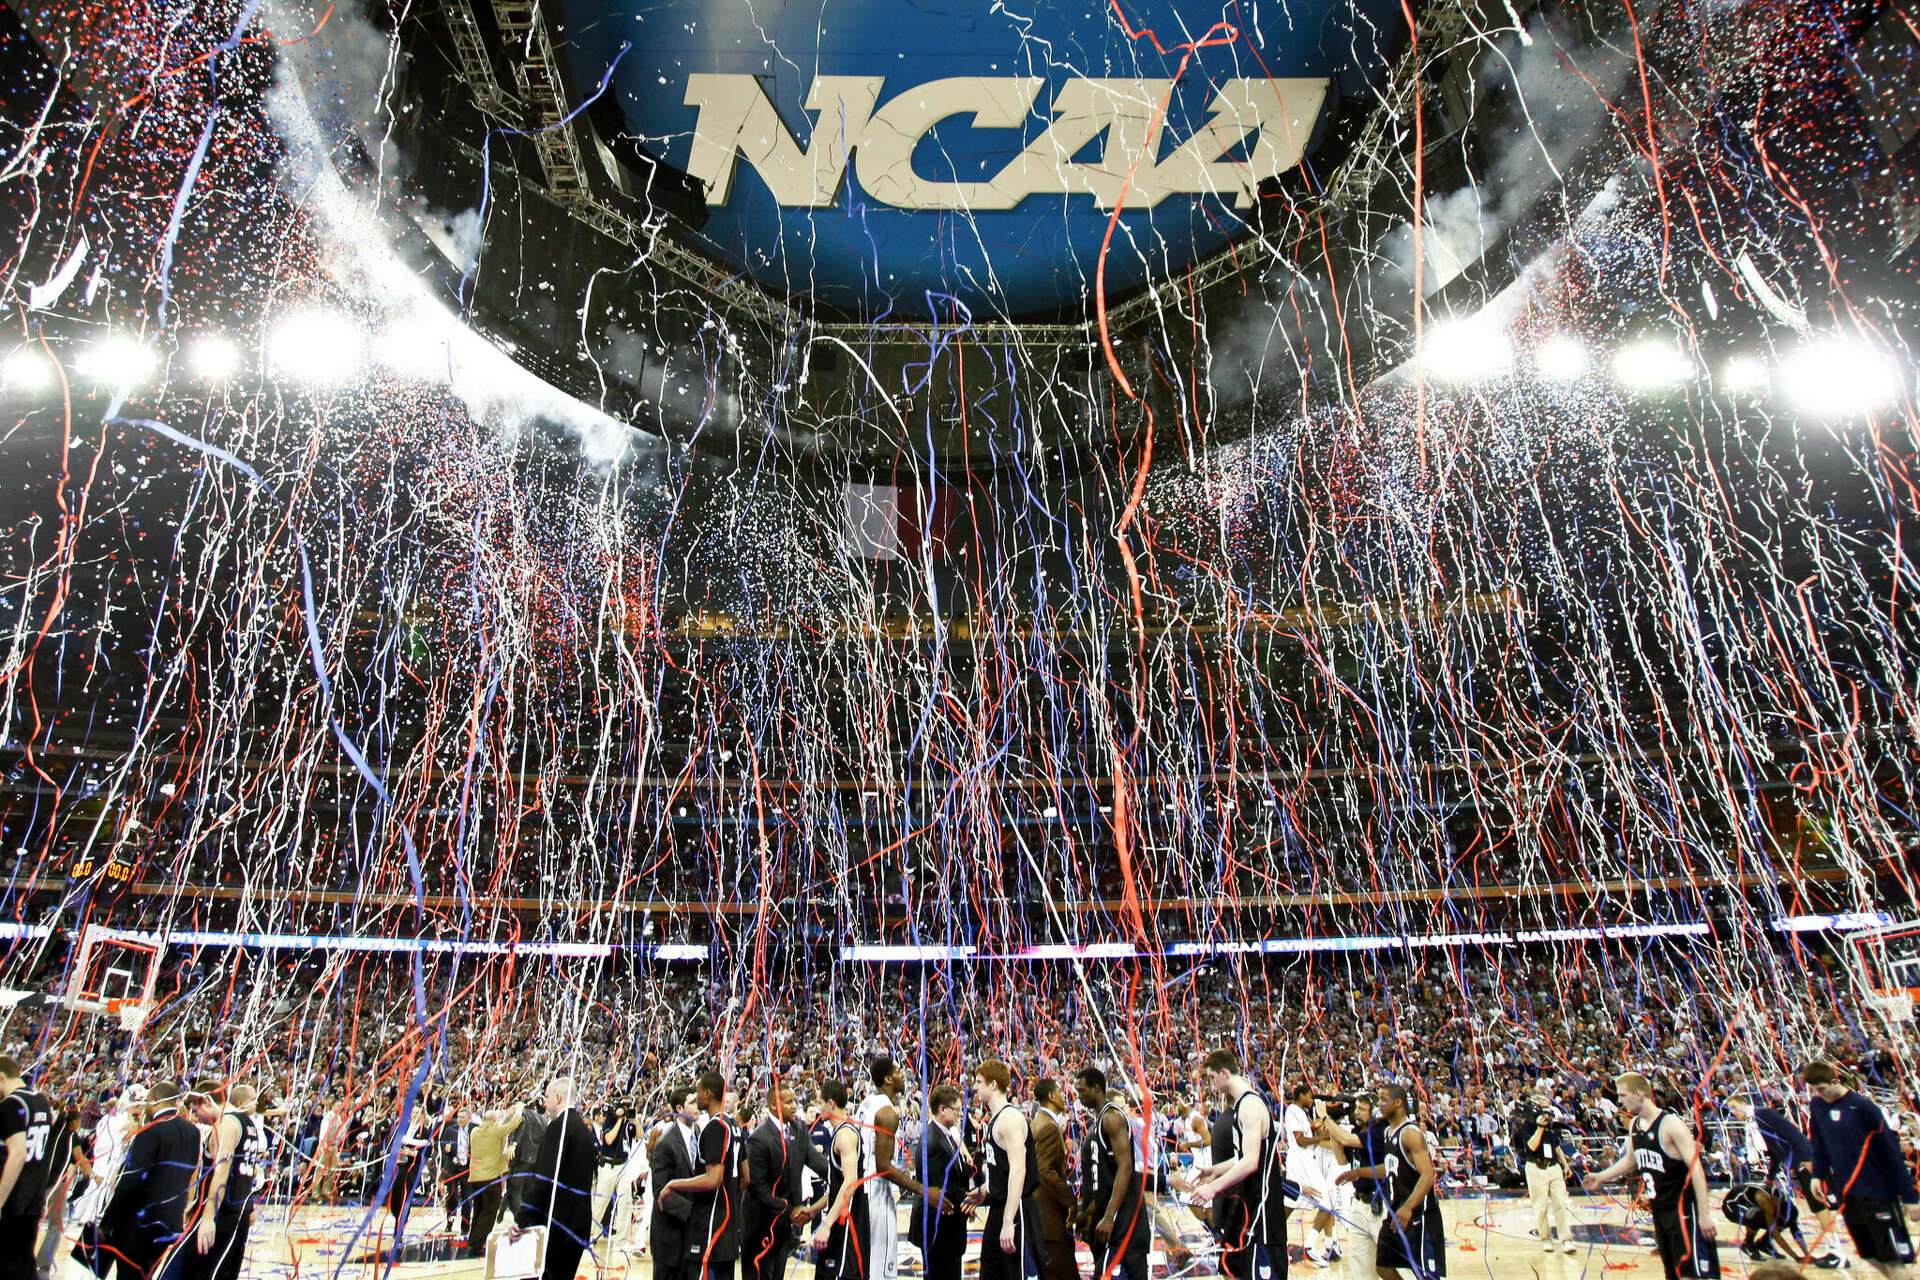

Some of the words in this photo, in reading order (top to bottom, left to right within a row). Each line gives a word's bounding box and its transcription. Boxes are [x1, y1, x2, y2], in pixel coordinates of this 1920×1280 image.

[684, 73, 1331, 210] NCAA
[107, 862, 129, 882] 00.0
[168, 932, 243, 946] DIVISION
[426, 940, 510, 954] NATIONAL
[1216, 941, 1262, 953] NCAA
[1266, 939, 1338, 951] DIVISION
[1407, 932, 1514, 947] BASKETBALL
[1517, 928, 1602, 943] NATIONAL
[1633, 1147, 1666, 1174] UTLER
[1642, 1172, 1657, 1200] 3
